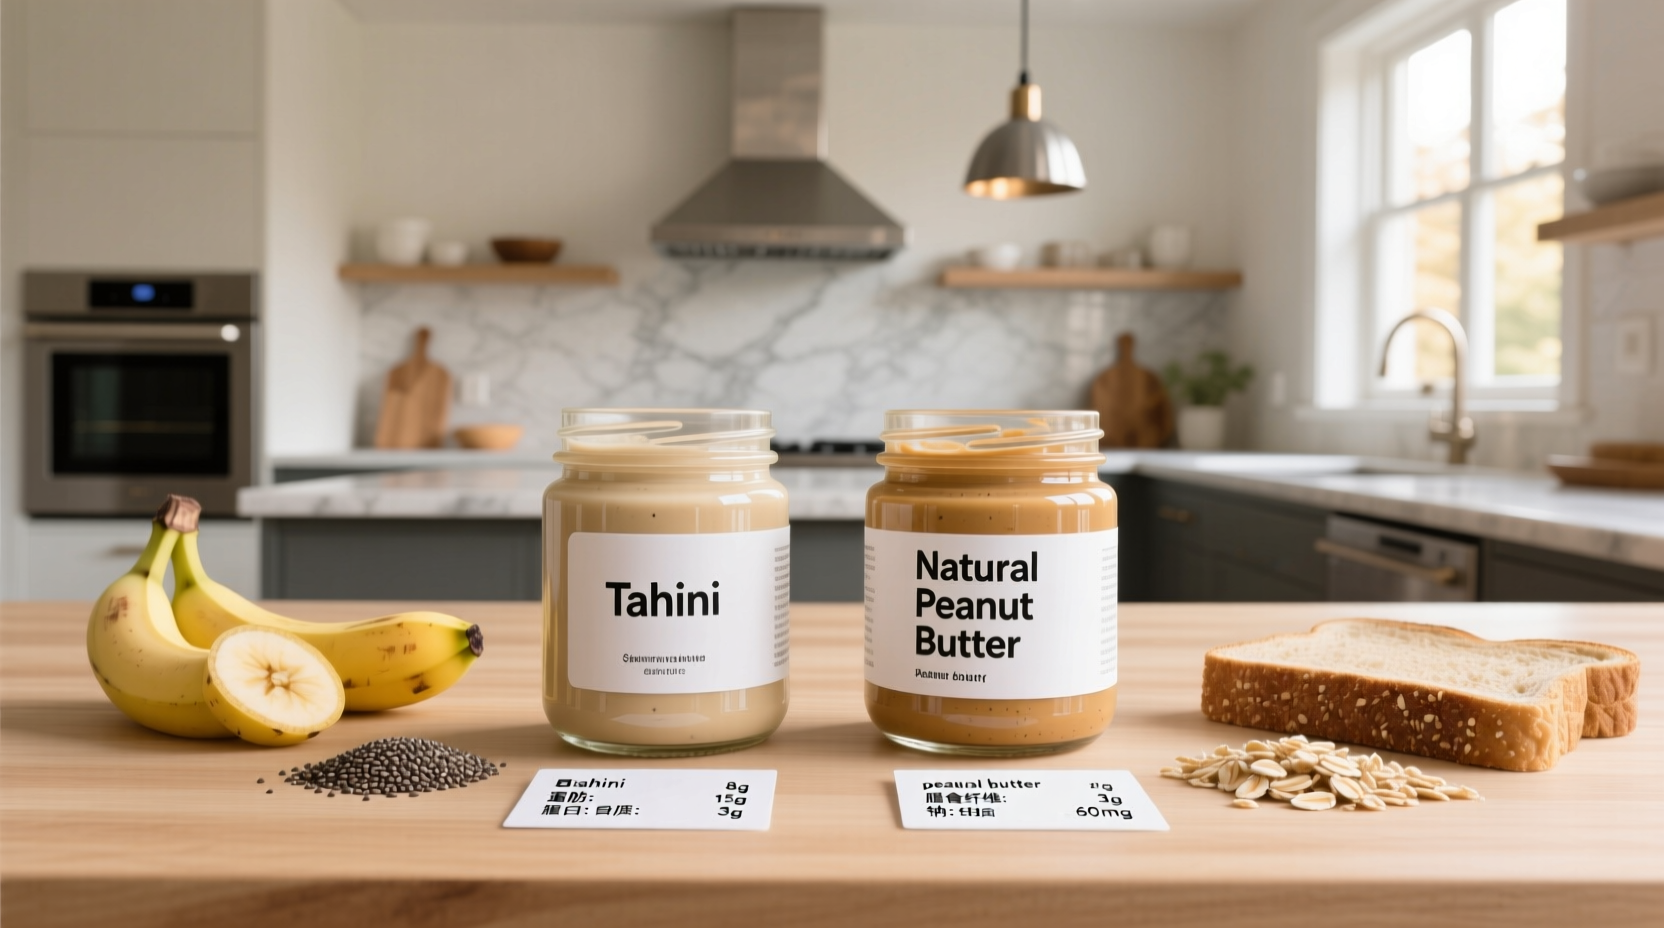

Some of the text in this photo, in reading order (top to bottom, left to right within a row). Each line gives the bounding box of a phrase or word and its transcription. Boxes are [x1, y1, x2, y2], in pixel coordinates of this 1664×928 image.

[915, 549, 1038, 583] Natural
[605, 580, 720, 618] Tahini
[915, 587, 1034, 621] Peanut
[915, 624, 1022, 659] Butter
[725, 781, 749, 794] 8g
[987, 778, 1041, 789] butter
[715, 793, 747, 806] 15g
[1097, 793, 1123, 807] 3g
[717, 806, 743, 820] 3g
[1075, 806, 1133, 820] 60mg
